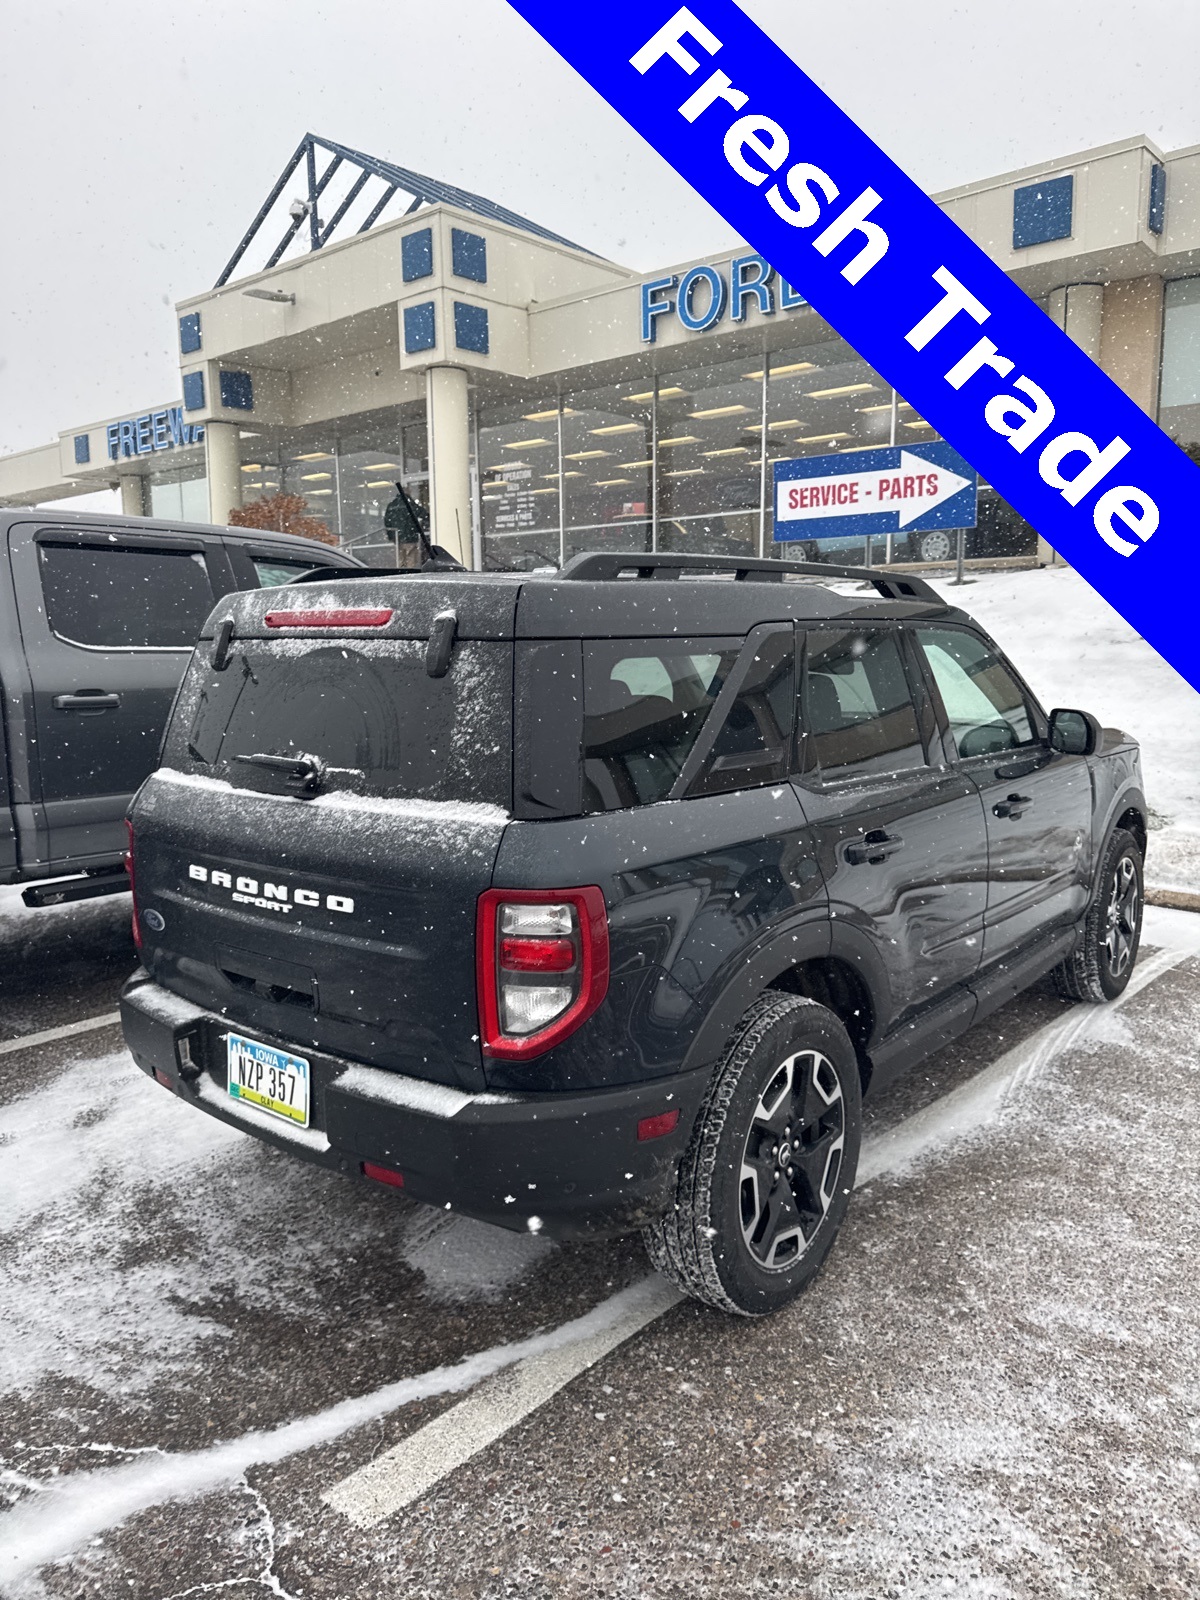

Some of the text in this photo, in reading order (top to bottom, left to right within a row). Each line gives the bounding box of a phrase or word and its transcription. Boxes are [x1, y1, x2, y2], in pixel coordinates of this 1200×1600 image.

[788, 482, 859, 509] SERVICE
[878, 473, 938, 501] PARTS
[189, 864, 354, 913] BRONCO
[232, 892, 293, 913] SPORT
[255, 1048, 279, 1067] IOWA
[239, 1055, 295, 1105] NZP 357
[260, 1096, 274, 1108] CLAY
